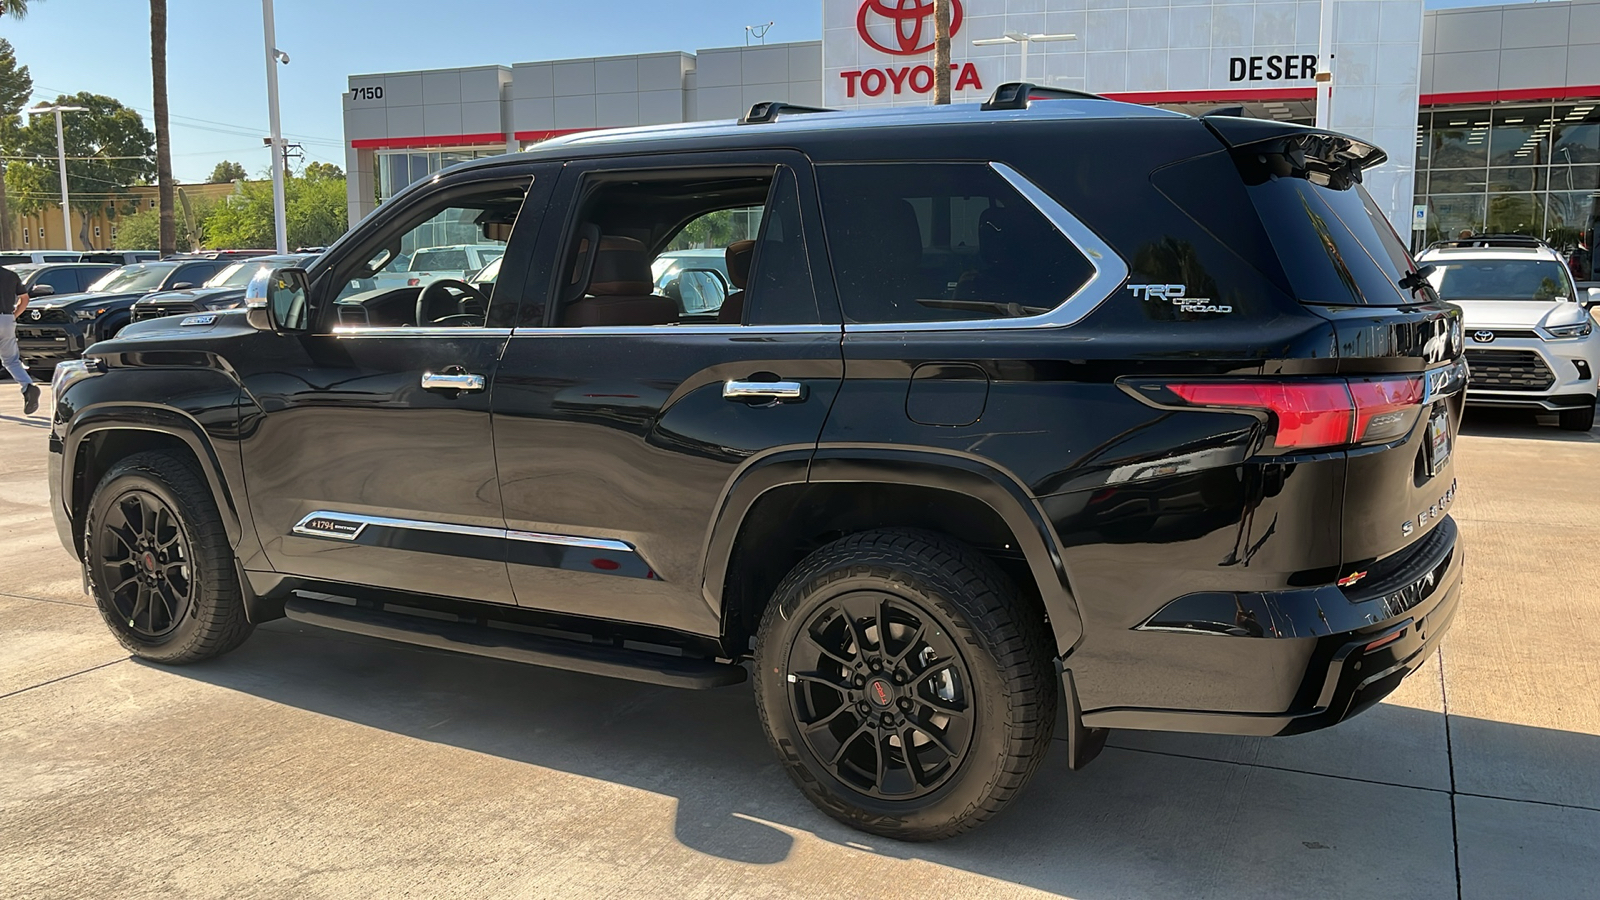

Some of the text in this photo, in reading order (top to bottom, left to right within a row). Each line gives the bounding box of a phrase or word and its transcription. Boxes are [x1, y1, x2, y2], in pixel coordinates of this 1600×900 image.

[1229, 54, 1334, 81] DESER
[840, 62, 983, 98] TOYOA
[351, 86, 383, 100] 7150
[1126, 284, 1186, 301] TRD
[1180, 305, 1232, 313] ROAD
[317, 520, 334, 530] 1794
